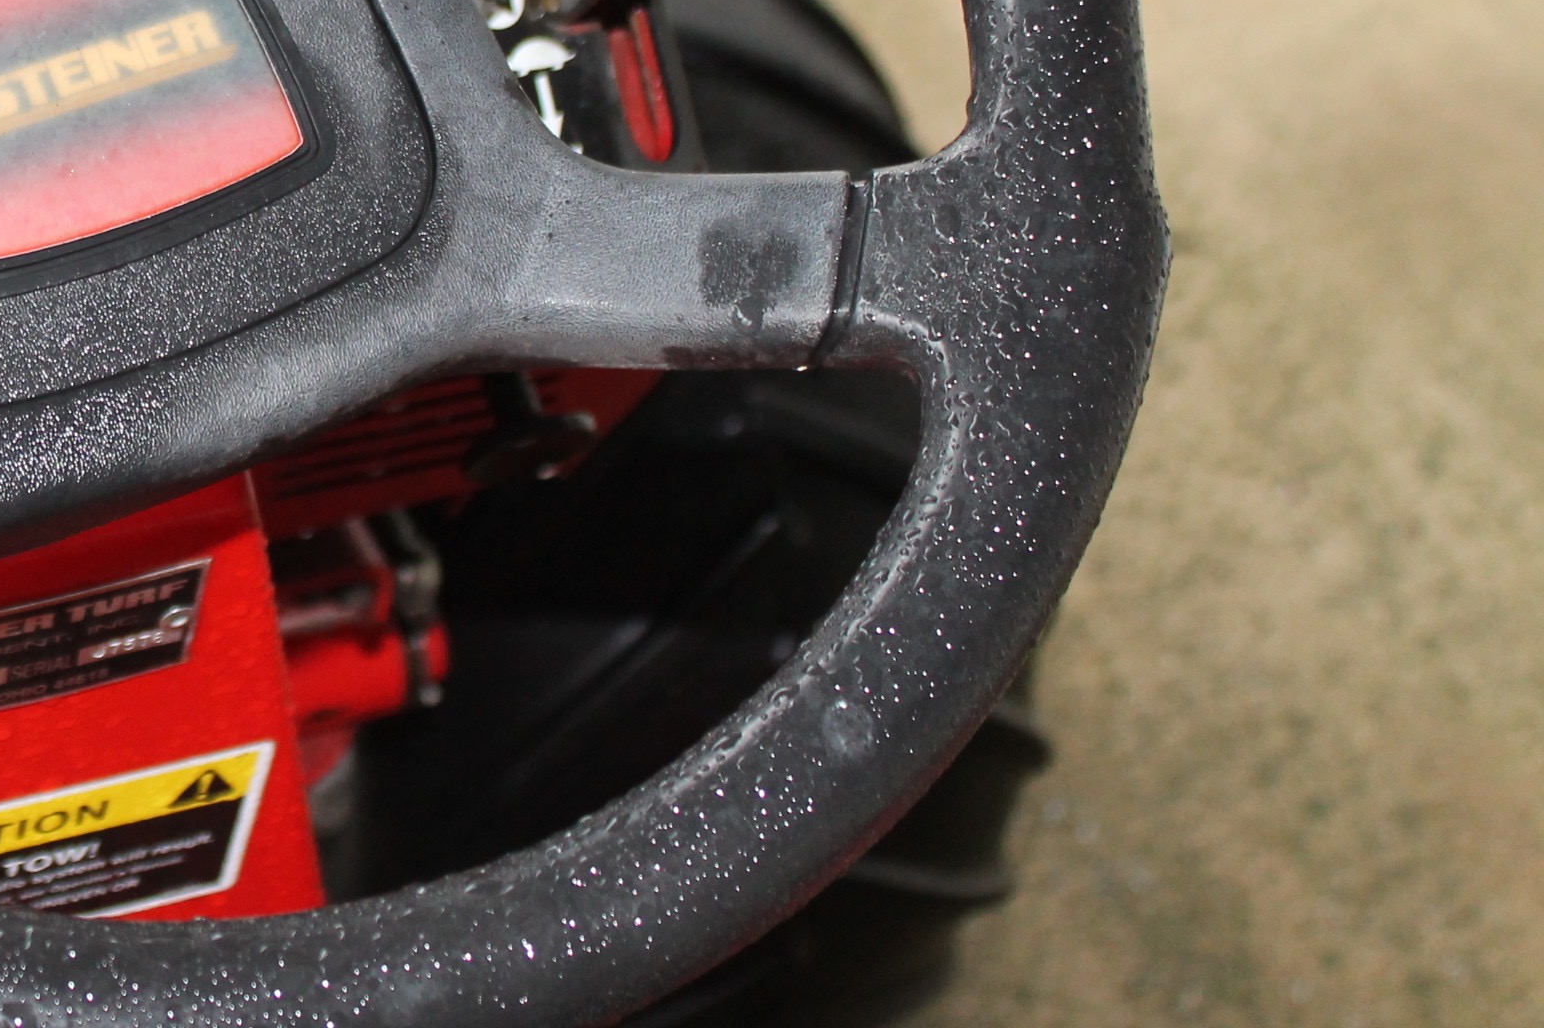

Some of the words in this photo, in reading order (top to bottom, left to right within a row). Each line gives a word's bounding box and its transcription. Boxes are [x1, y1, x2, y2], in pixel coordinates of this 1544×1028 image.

[66, 579, 189, 622] TURF
[11, 655, 71, 679] SERIAL
[1, 840, 103, 878] TOW!
[30, 858, 107, 885] system
